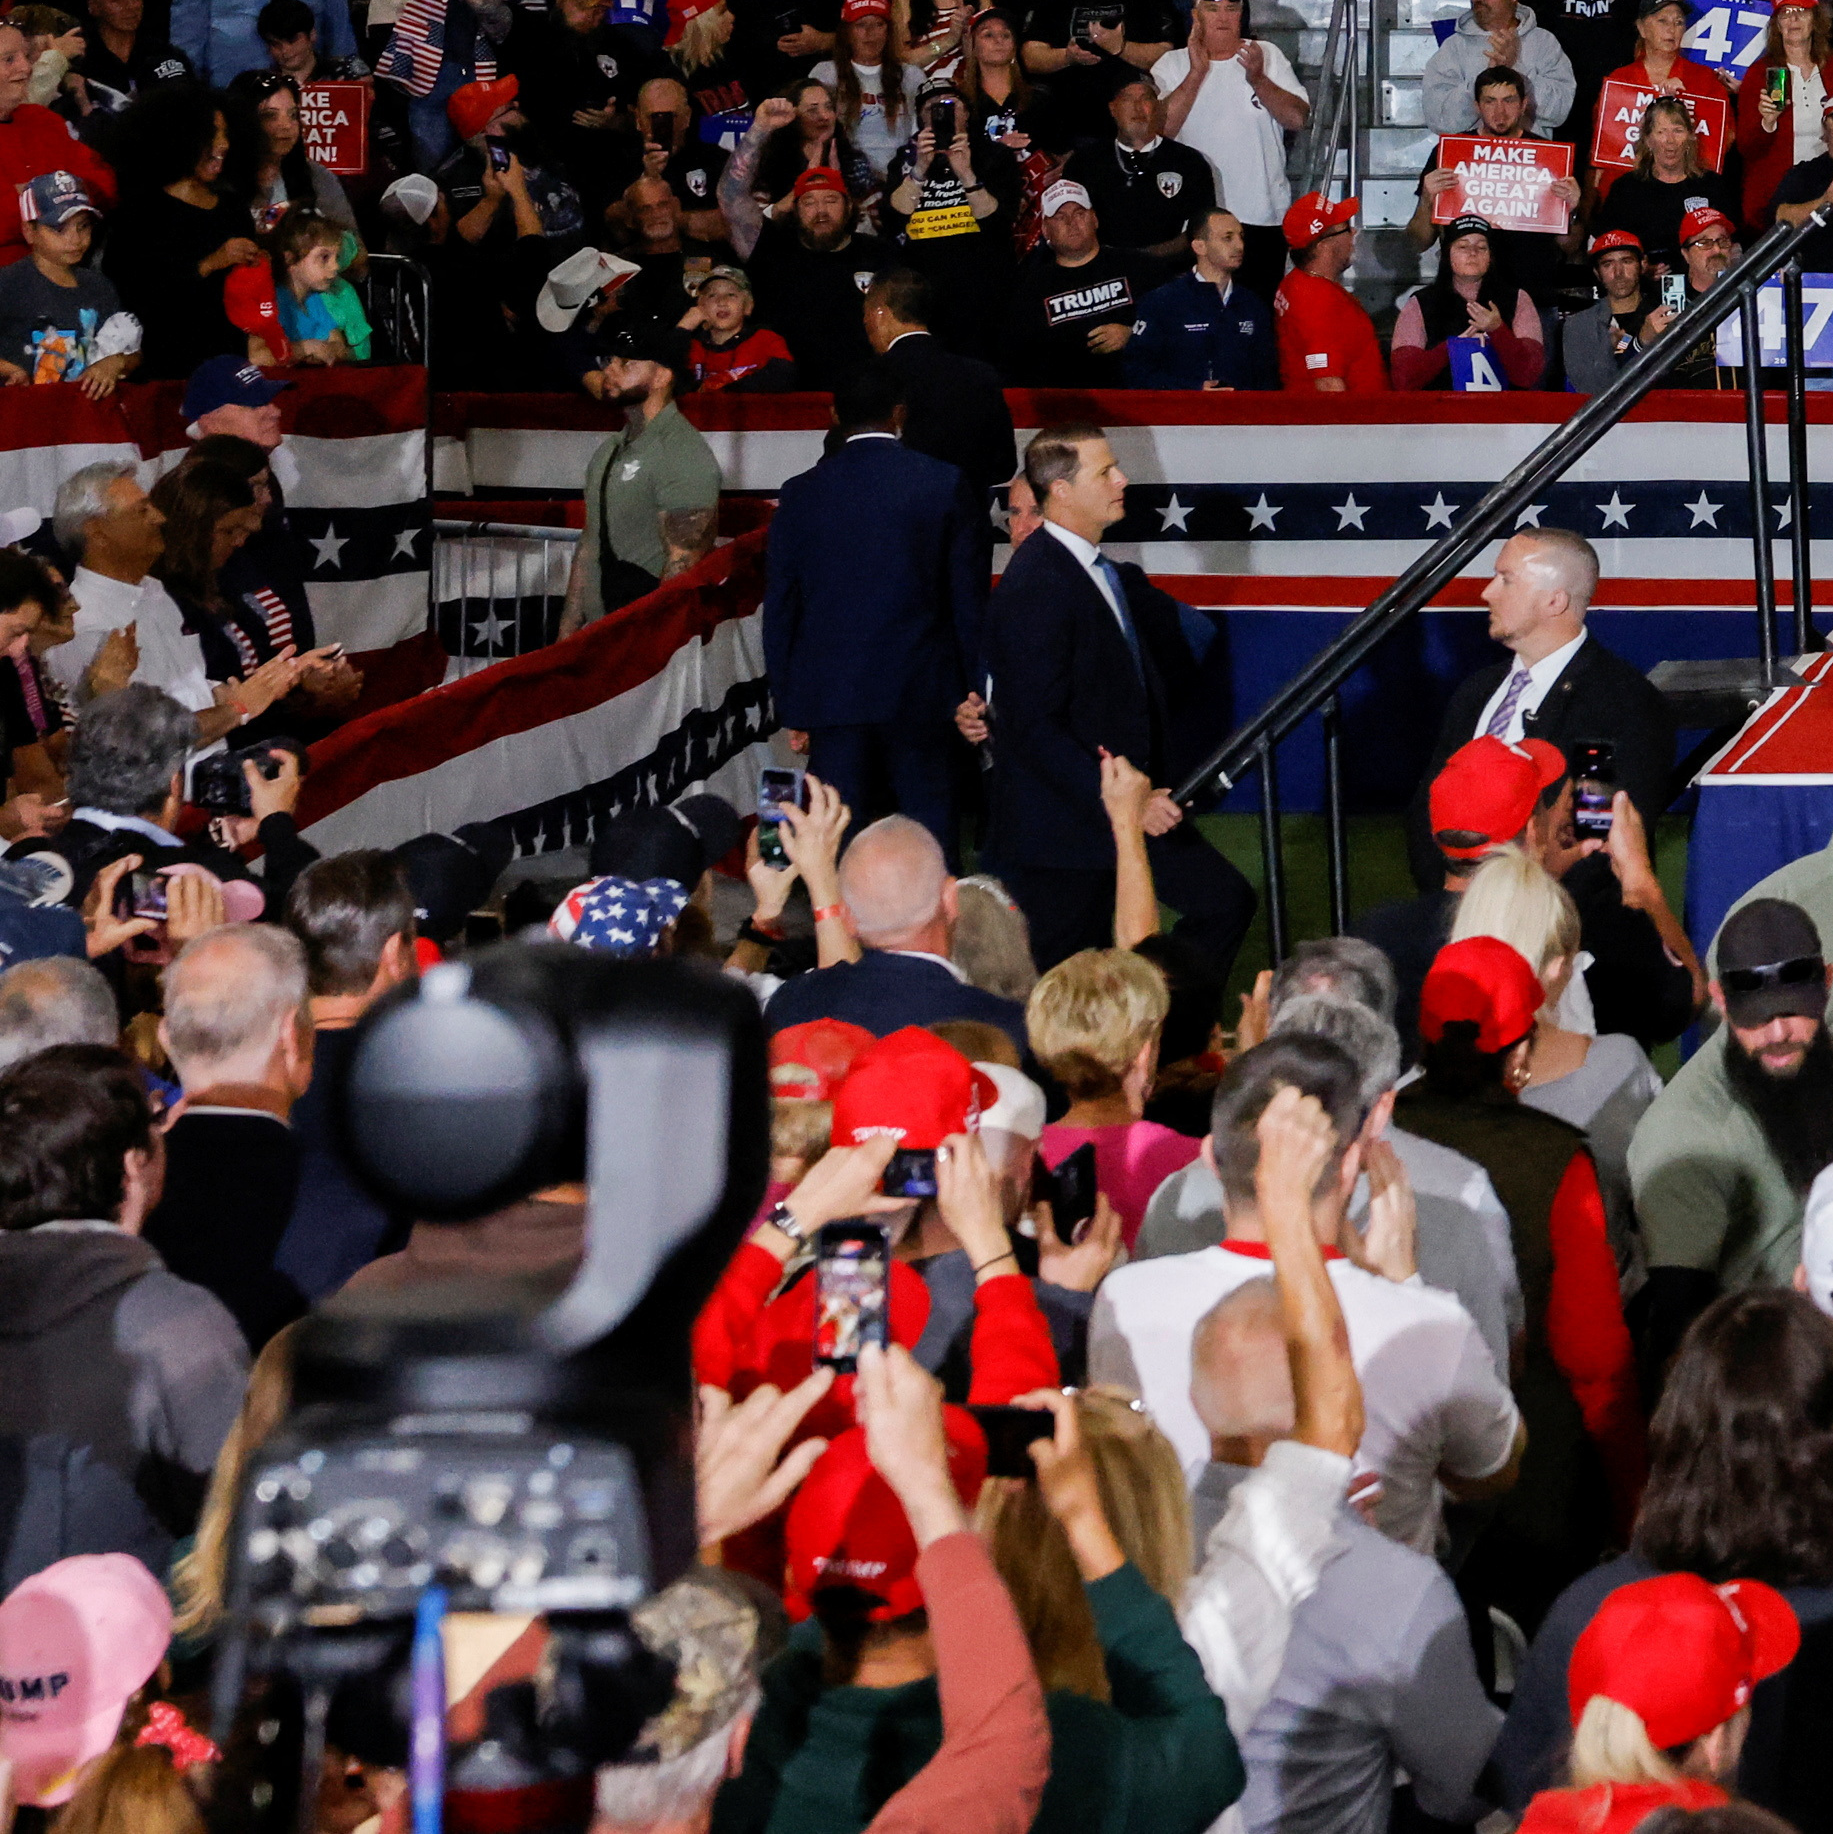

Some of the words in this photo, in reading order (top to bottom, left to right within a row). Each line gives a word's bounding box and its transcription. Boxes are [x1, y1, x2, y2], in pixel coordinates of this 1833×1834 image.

[1680, 5, 1775, 64] 47
[1473, 145, 1537, 165] MAKE
[1454, 162, 1555, 183] AMERICA
[1464, 180, 1539, 200] GREAT
[1460, 198, 1539, 219] AGAIN!
[1049, 282, 1122, 313] TRUMP
